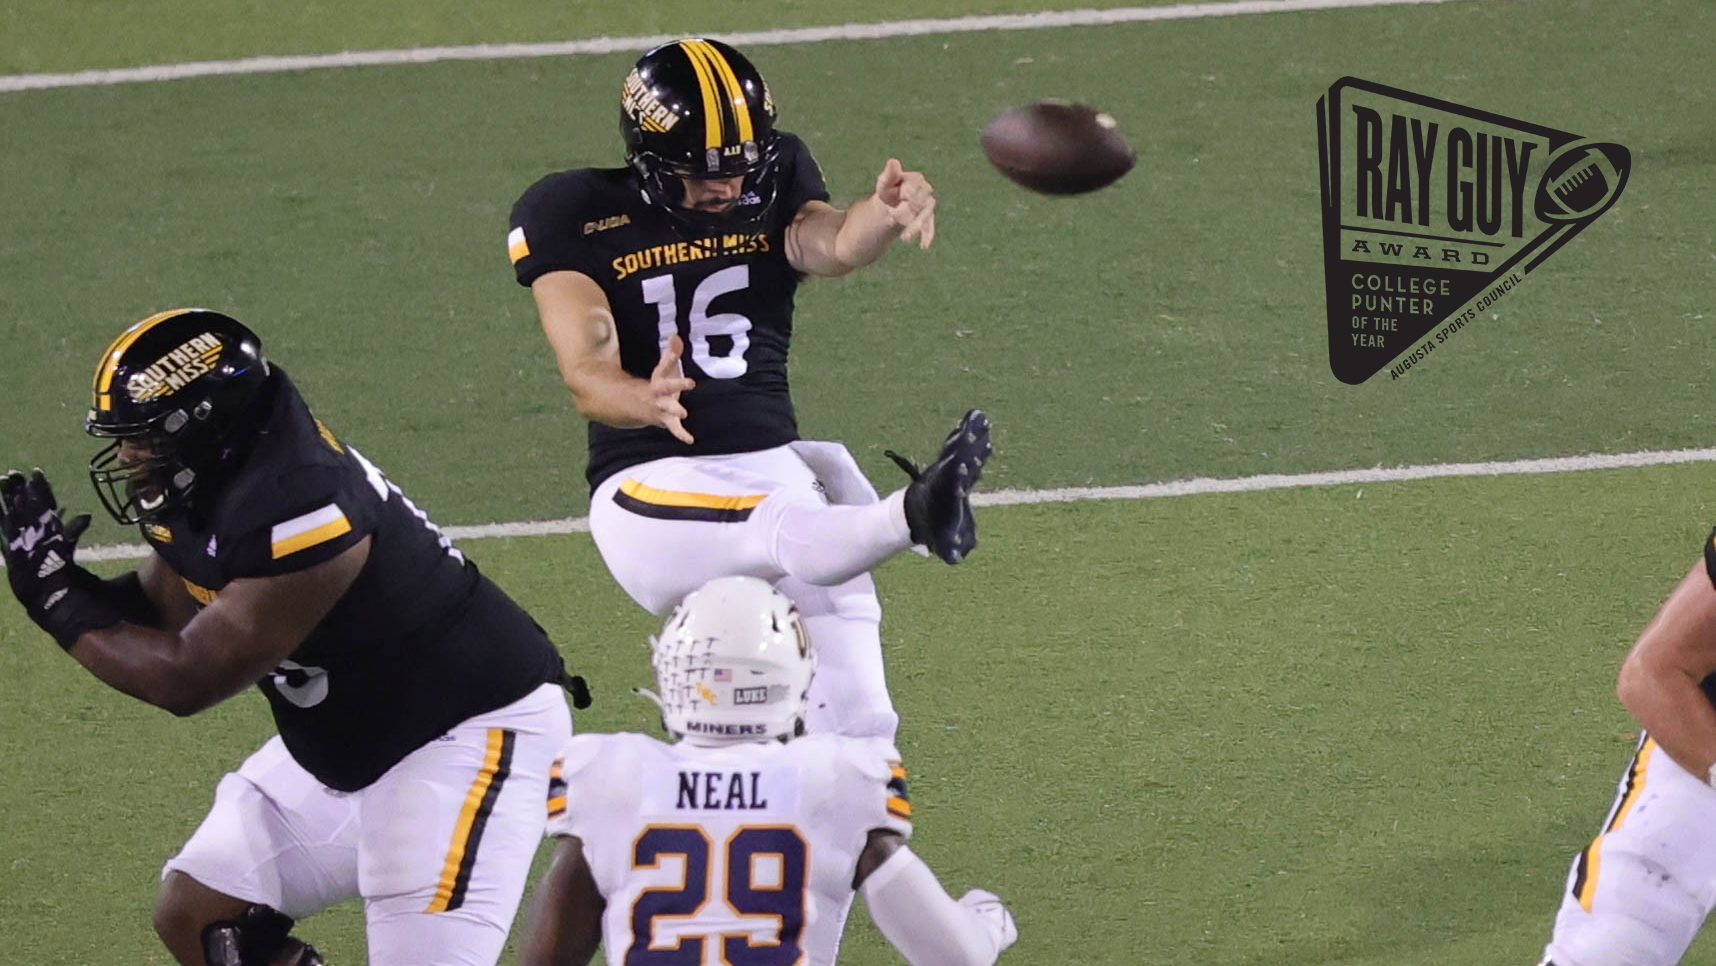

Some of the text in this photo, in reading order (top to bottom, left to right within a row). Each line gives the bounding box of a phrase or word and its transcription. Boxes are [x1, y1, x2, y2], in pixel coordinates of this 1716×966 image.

[612, 237, 718, 280] SOUTHERN
[641, 264, 753, 379] 16
[127, 332, 222, 399] SOUTHERN
[165, 358, 209, 391] MISS
[735, 689, 766, 703] LUKE
[686, 721, 767, 735] MINERS
[676, 771, 768, 810] NEAL
[624, 823, 811, 966] 29
